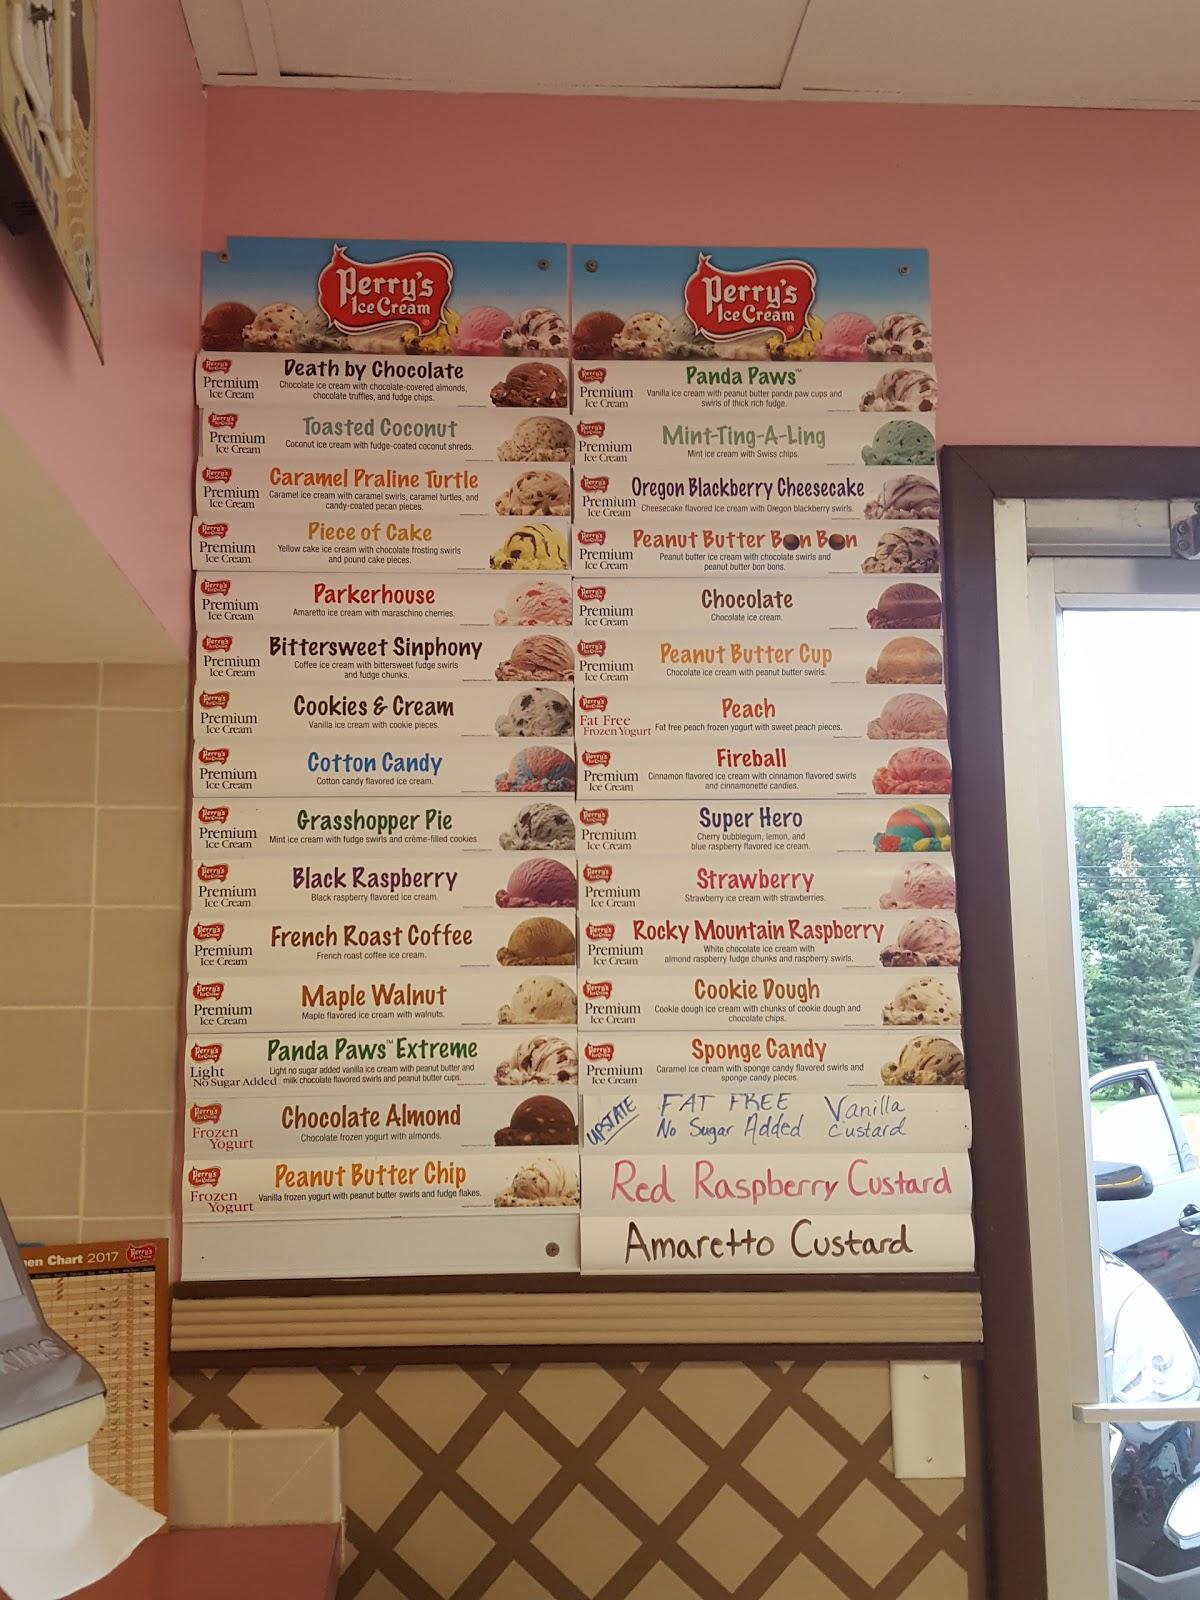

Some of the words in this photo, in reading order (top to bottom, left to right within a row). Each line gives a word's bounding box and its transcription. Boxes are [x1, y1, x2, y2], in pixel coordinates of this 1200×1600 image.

[336, 266, 434, 308] Perry's
[701, 275, 798, 316] Perry's
[285, 359, 339, 377] Death
[345, 360, 367, 380] by
[372, 360, 464, 379] Chocolate
[686, 366, 743, 385] Panda
[203, 376, 259, 389] Premium
[580, 386, 633, 398] Premium
[209, 389, 223, 398] Ice
[224, 389, 254, 399] Cream
[585, 399, 599, 408] Ice
[600, 399, 629, 408] Cream
[302, 416, 374, 436] Toasted
[380, 417, 458, 438] Coconut
[662, 425, 825, 449] Mint-Ting-A-Ling
[270, 467, 348, 487] Caramel
[354, 468, 420, 488] Praline
[425, 470, 478, 489] Turtle
[203, 486, 260, 499] Premium
[632, 477, 685, 500] Oregon
[688, 477, 773, 500] Blackberry
[777, 477, 865, 497] Cheesecake
[209, 499, 223, 508] Ice
[225, 499, 255, 509] Cream
[308, 521, 356, 541] Piece
[360, 522, 382, 541] of
[386, 523, 432, 542] Cake
[633, 529, 698, 548] Peanut
[702, 530, 766, 549] Butter
[314, 583, 435, 604] Parkerhouse
[701, 589, 793, 609] Chocolate
[579, 605, 633, 616] Premium
[710, 613, 745, 621] Chocolate
[747, 613, 758, 621] ice
[585, 618, 598, 626] Ice
[599, 618, 628, 626] Cream
[270, 636, 388, 656] Bittersweet
[393, 636, 483, 659] Sinphony
[660, 642, 726, 664] Peanut
[730, 643, 794, 664] Butter
[799, 643, 832, 668] Cup
[294, 695, 368, 716] Cookies
[373, 695, 388, 716] &
[393, 695, 454, 716] Cream
[722, 698, 775, 719] Peach
[580, 715, 599, 726] Fat
[603, 715, 631, 726] Free
[655, 723, 666, 731] Fat
[668, 723, 682, 731] free
[683, 723, 705, 733] peach
[707, 723, 729, 731] frozen
[730, 723, 753, 733] yogurt
[754, 723, 770, 731] with
[771, 723, 793, 731] sweet
[794, 723, 816, 732] peach
[583, 727, 617, 736] Frozen
[618, 726, 651, 738] Yogurt
[308, 751, 379, 773] Cotton
[382, 752, 443, 776] Candy
[717, 748, 787, 768] Fireball
[200, 768, 257, 780] Premium
[205, 780, 220, 789] Ice
[222, 781, 252, 789] Cream
[297, 809, 420, 833] Grasshopper
[425, 809, 452, 830] Pie
[699, 807, 755, 830] Super
[759, 806, 803, 828] Hero
[293, 866, 347, 889] Black
[352, 866, 458, 892] Raspberry
[696, 867, 814, 892] Strawberry
[311, 893, 332, 902] Black
[333, 893, 368, 903] raspberry
[370, 893, 399, 901] flavored
[401, 893, 412, 901] ice
[271, 924, 337, 948] French
[344, 925, 403, 946] Roast
[408, 924, 473, 946] Coffee
[633, 919, 690, 944] Rocky
[694, 919, 785, 941] Mountain
[788, 919, 884, 944] Raspberry
[194, 944, 253, 956] Premium
[200, 957, 215, 966] Ice
[216, 957, 248, 966] Cream
[302, 984, 366, 1009] Maple
[371, 983, 447, 1007] Walnut
[694, 978, 758, 1000] Cookie
[762, 977, 820, 1003] Dough
[585, 1003, 641, 1014] Premium
[590, 1015, 604, 1024] Ice
[606, 1015, 636, 1024] Cream
[268, 1039, 329, 1062] Panda
[396, 1037, 478, 1059] Extreme
[692, 1038, 762, 1063] Sponge
[766, 1037, 827, 1063] Candy
[190, 1066, 224, 1078] Light
[193, 1078, 209, 1087] No
[211, 1078, 240, 1089] Sugar
[243, 1076, 277, 1086] Added
[660, 1093, 716, 1117] FAT
[729, 1092, 792, 1111] FREE
[824, 1095, 905, 1122] Vanilla
[282, 1104, 380, 1129] Chocolate
[385, 1103, 461, 1127] Almond
[586, 1095, 637, 1146] UPSTATE
[192, 1127, 238, 1138] Frozen
[300, 1133, 338, 1142] Chocolate
[340, 1133, 363, 1142] frozen
[364, 1132, 389, 1143] yogurt
[390, 1132, 407, 1140] with
[656, 1117, 677, 1139] No
[689, 1116, 735, 1145] Sugar
[744, 1112, 804, 1146] Added
[208, 1138, 253, 1152] Yogurt
[275, 1164, 346, 1188] Peanut
[351, 1163, 419, 1187] Butter
[424, 1161, 466, 1189] Chip
[611, 1159, 676, 1203] Red
[695, 1160, 839, 1205] Raspberry
[848, 1159, 952, 1196] Custard
[190, 1191, 237, 1201] Frozen
[258, 1193, 282, 1202] Vanilla
[284, 1193, 307, 1201] frozen
[308, 1192, 331, 1202] yogurt
[332, 1192, 348, 1200] with
[349, 1191, 375, 1201] peanut
[376, 1191, 397, 1199] butter
[399, 1190, 420, 1199] swirls
[421, 1190, 435, 1198] and
[437, 1189, 457, 1199] fudge
[208, 1202, 254, 1214] Yogurt
[625, 1221, 775, 1264] Amaretto
[791, 1218, 913, 1258] Custard
[47, 1254, 84, 1266] Chart
[87, 1251, 120, 1264] 2017
